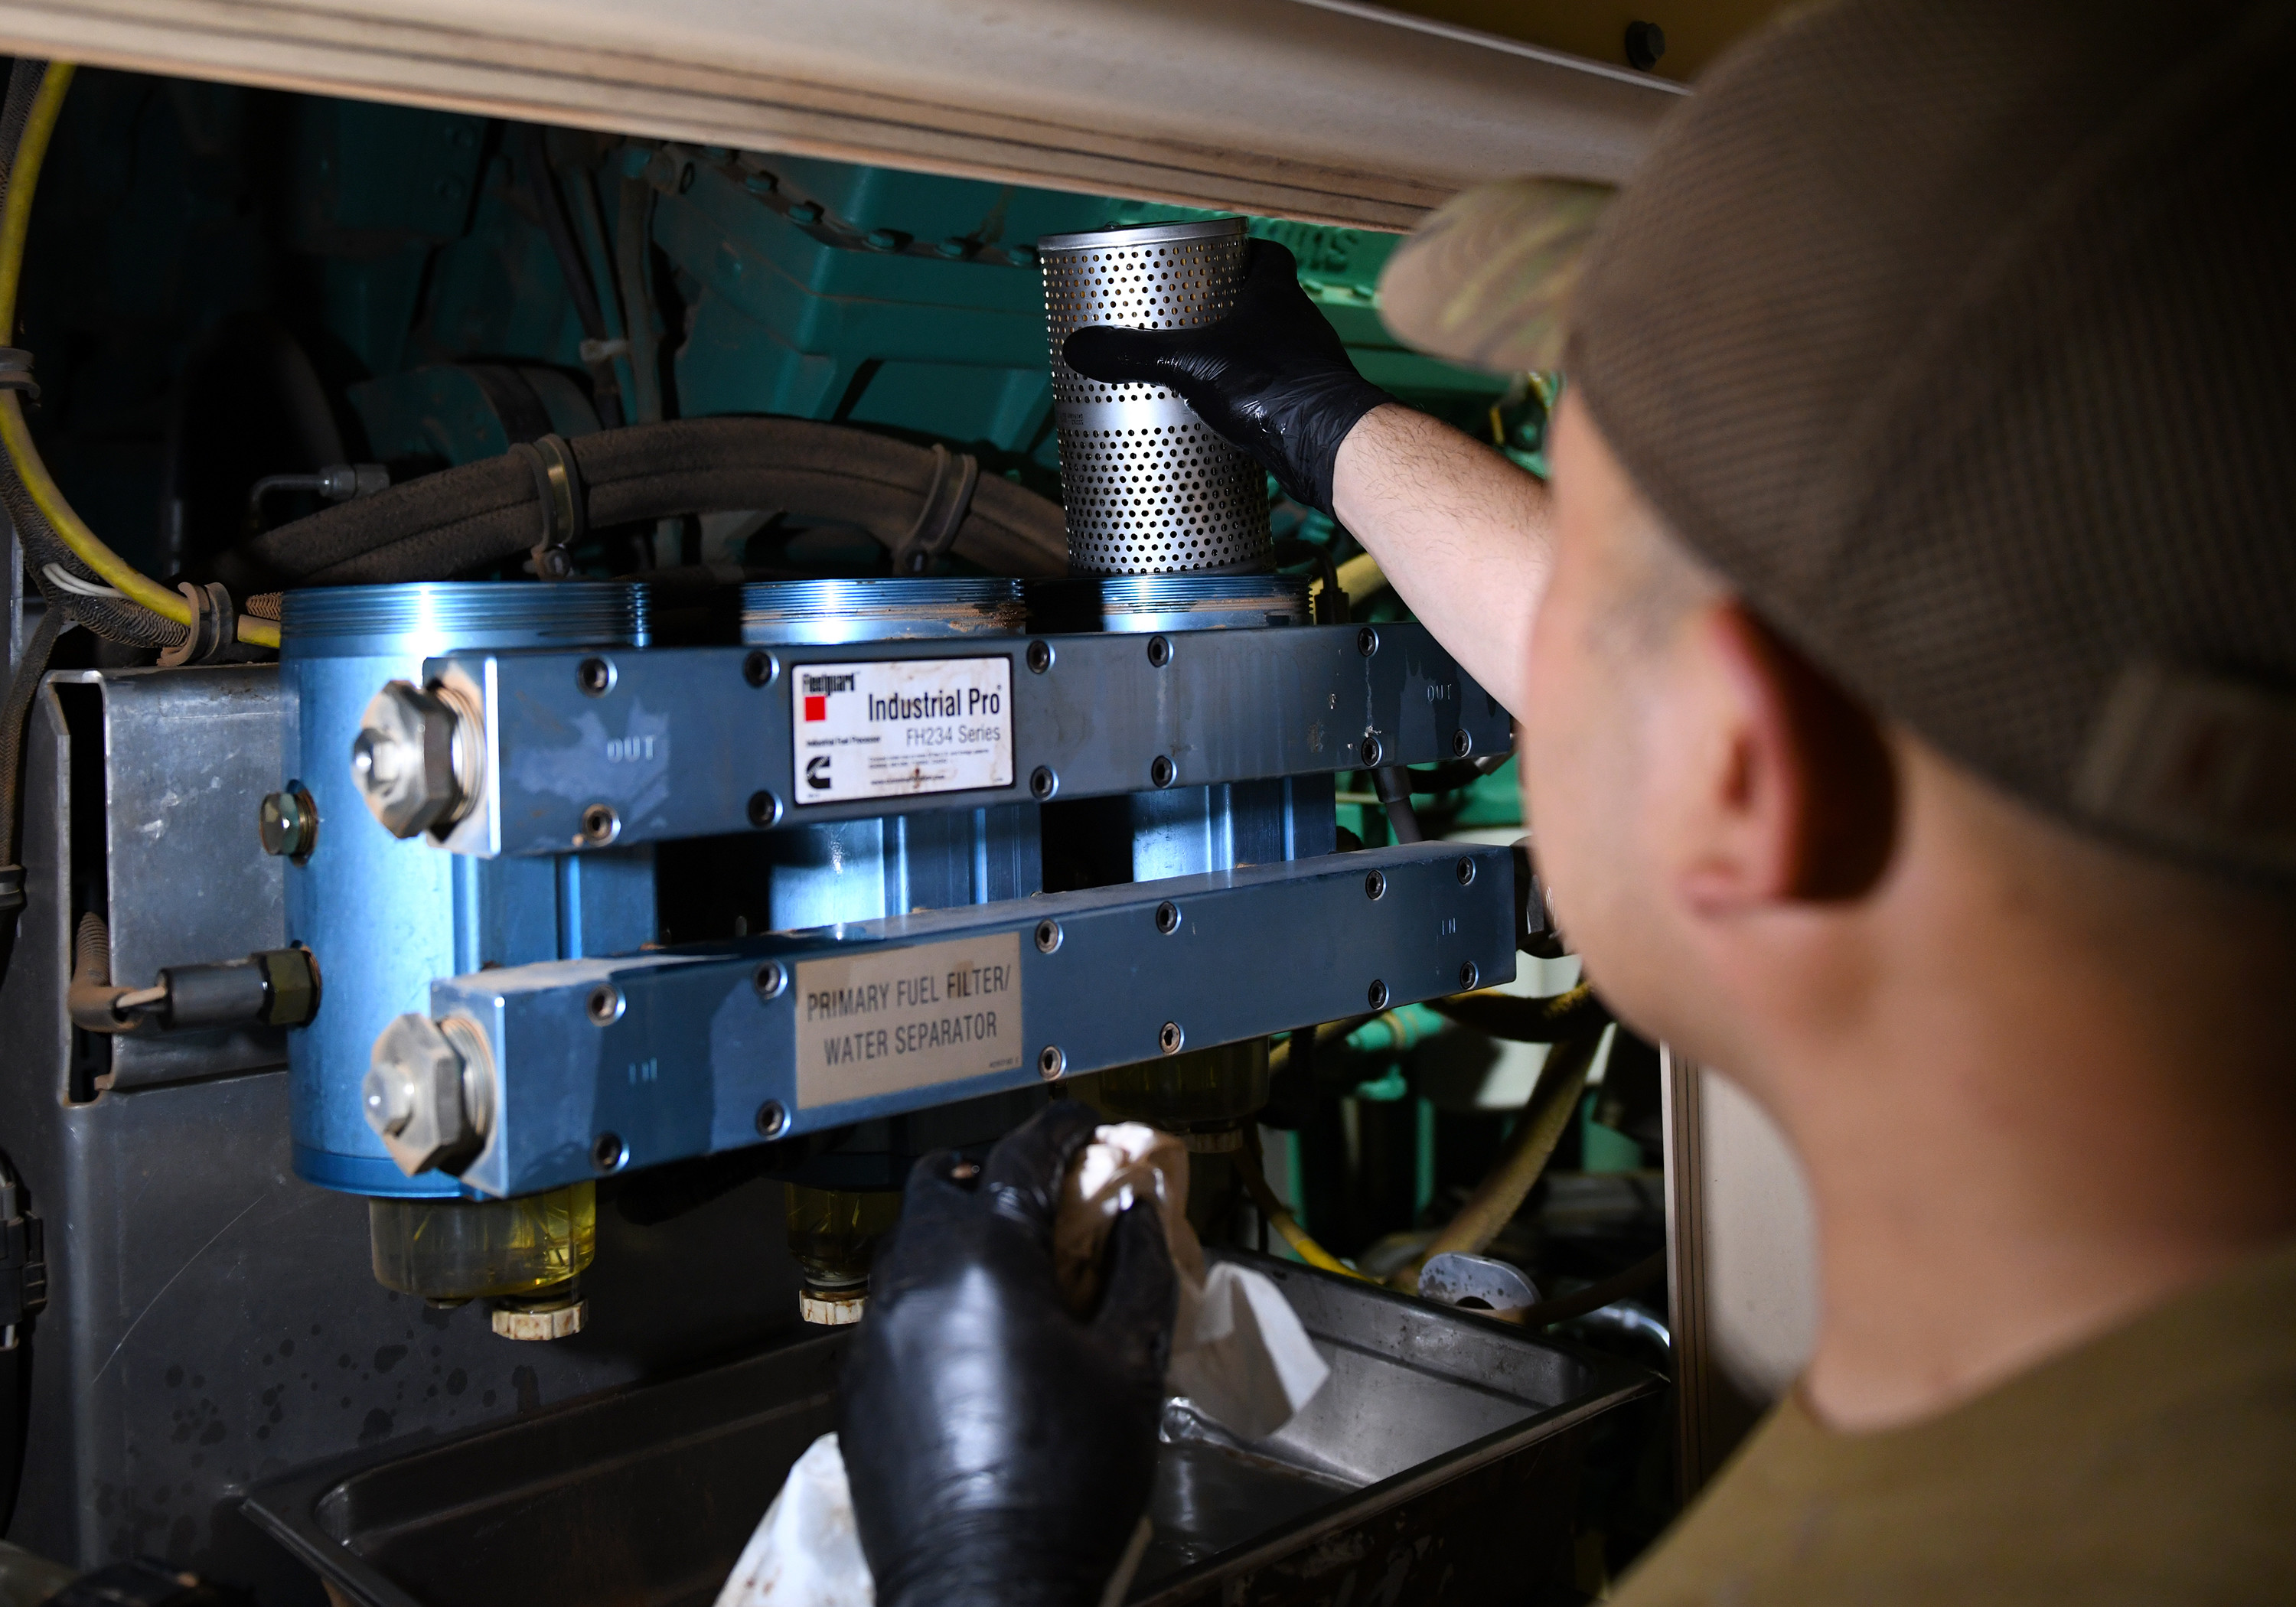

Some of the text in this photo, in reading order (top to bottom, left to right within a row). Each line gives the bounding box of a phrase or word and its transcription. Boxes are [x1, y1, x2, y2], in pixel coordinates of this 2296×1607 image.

[869, 688, 960, 722] Industrial
[1427, 683, 1452, 702] OUT
[607, 735, 654, 763] OUT
[906, 724, 1001, 748] FH234 Series
[1442, 918, 1456, 936] IN
[807, 964, 1011, 1023] PRIMARY FUEL FILTER/
[823, 1011, 997, 1067] WATER SEPARATOR
